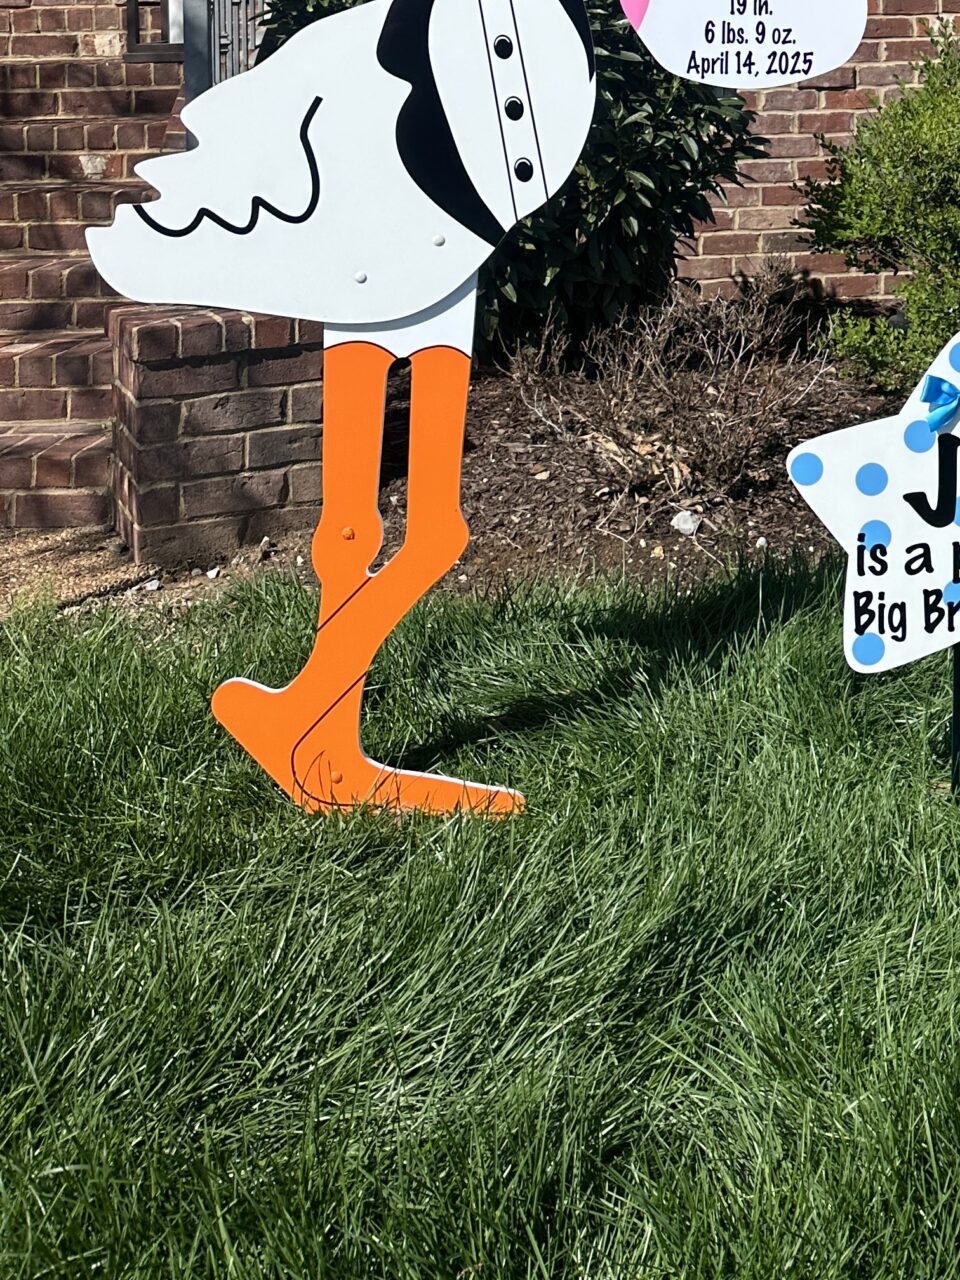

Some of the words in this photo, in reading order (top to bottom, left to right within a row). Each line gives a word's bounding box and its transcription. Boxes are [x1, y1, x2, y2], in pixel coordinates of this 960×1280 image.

[704, 20, 715, 44] 6
[721, 21, 749, 45] lbs.
[755, 21, 766, 44] 9
[772, 28, 796, 45] oz.
[686, 50, 729, 79] April
[735, 51, 760, 78] 14,
[766, 51, 814, 75] 2025
[856, 532, 888, 577] is
[904, 542, 934, 576] a
[852, 590, 907, 642] Big
